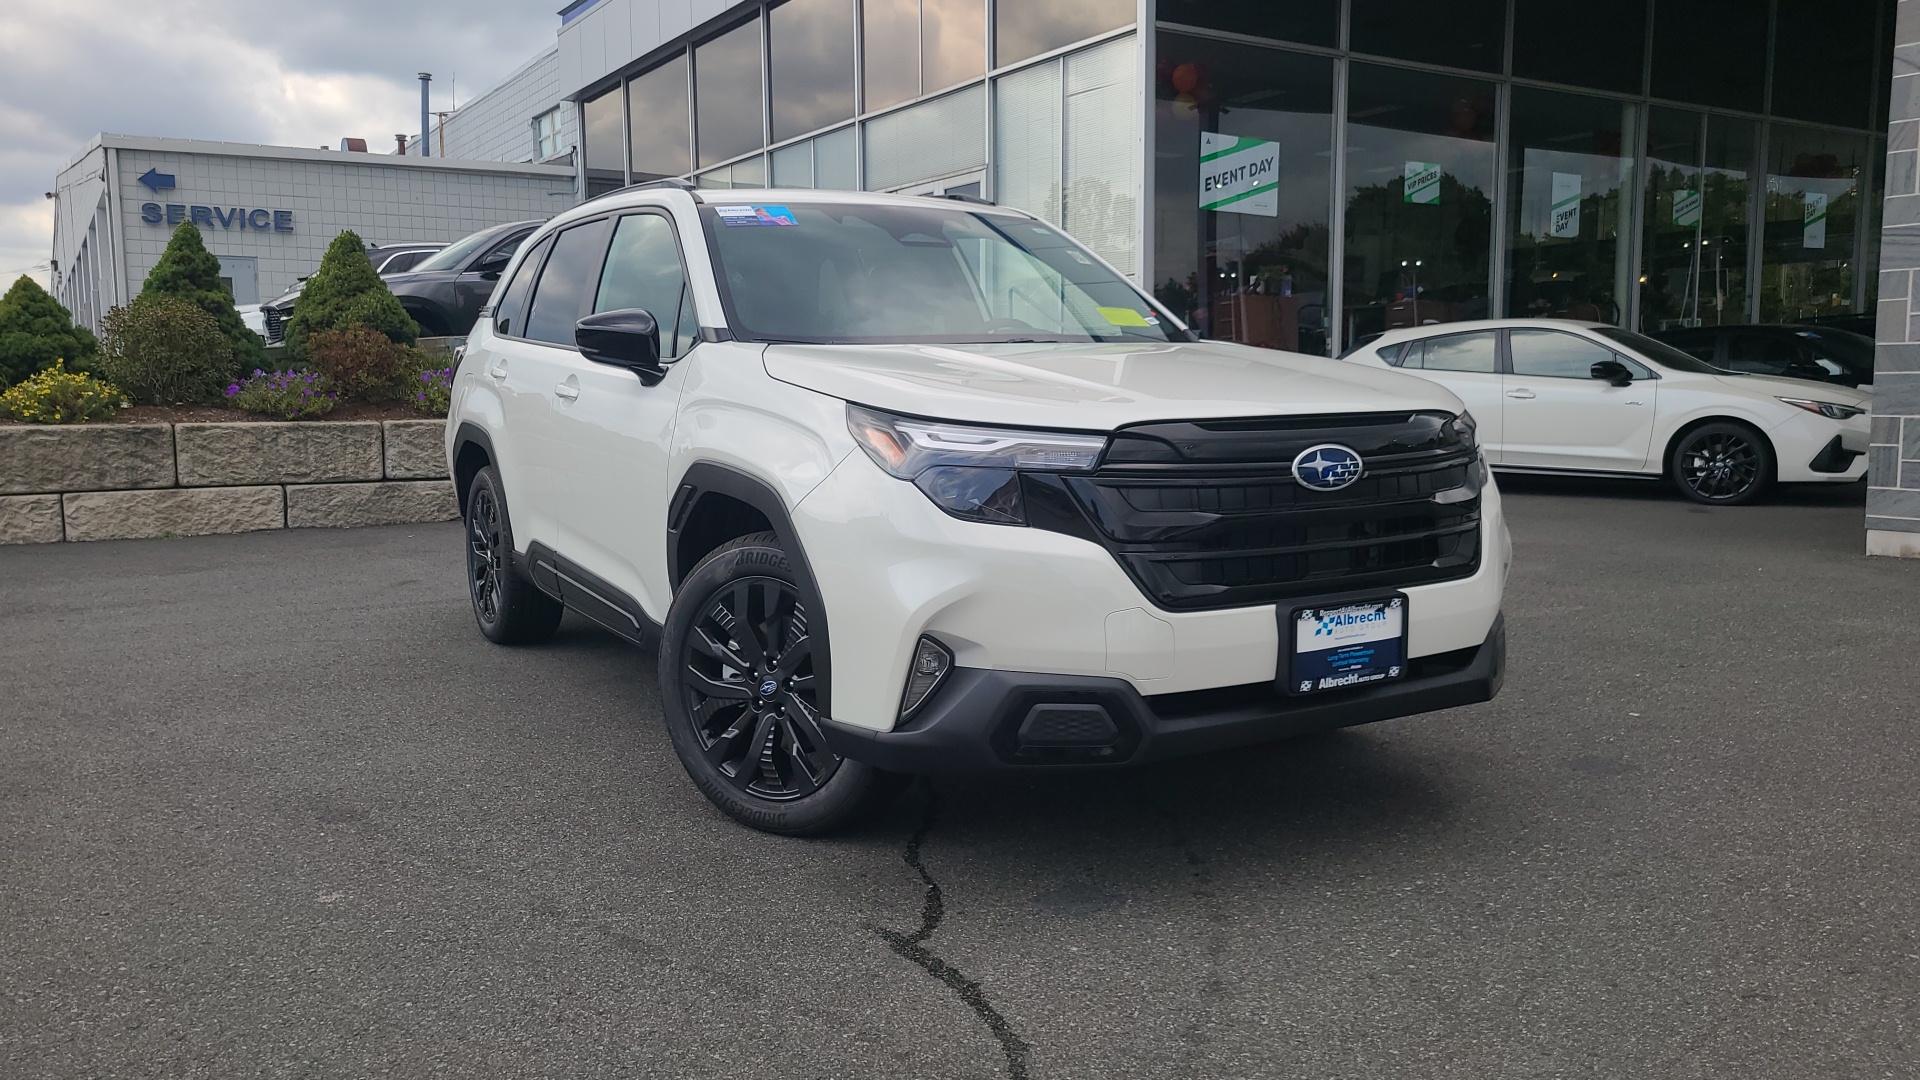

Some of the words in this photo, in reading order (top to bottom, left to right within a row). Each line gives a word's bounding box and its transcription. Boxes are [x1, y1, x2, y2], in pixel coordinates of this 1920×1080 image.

[1205, 165, 1246, 192] EVENT
[1249, 156, 1274, 178] DAY
[1407, 180, 1417, 190] VIP
[1417, 170, 1437, 186] PRICES
[1806, 196, 1822, 212] EVENT
[141, 202, 294, 232] SERVICE
[1556, 207, 1577, 223] EVENT
[1556, 220, 1569, 233] DAY
[1334, 610, 1386, 627] Albrecht
[1334, 625, 1355, 634] AUTO
[1358, 621, 1387, 632] GROUP
[1318, 672, 1358, 690] Albrecht
[702, 776, 788, 827] BRIDGESTONE
